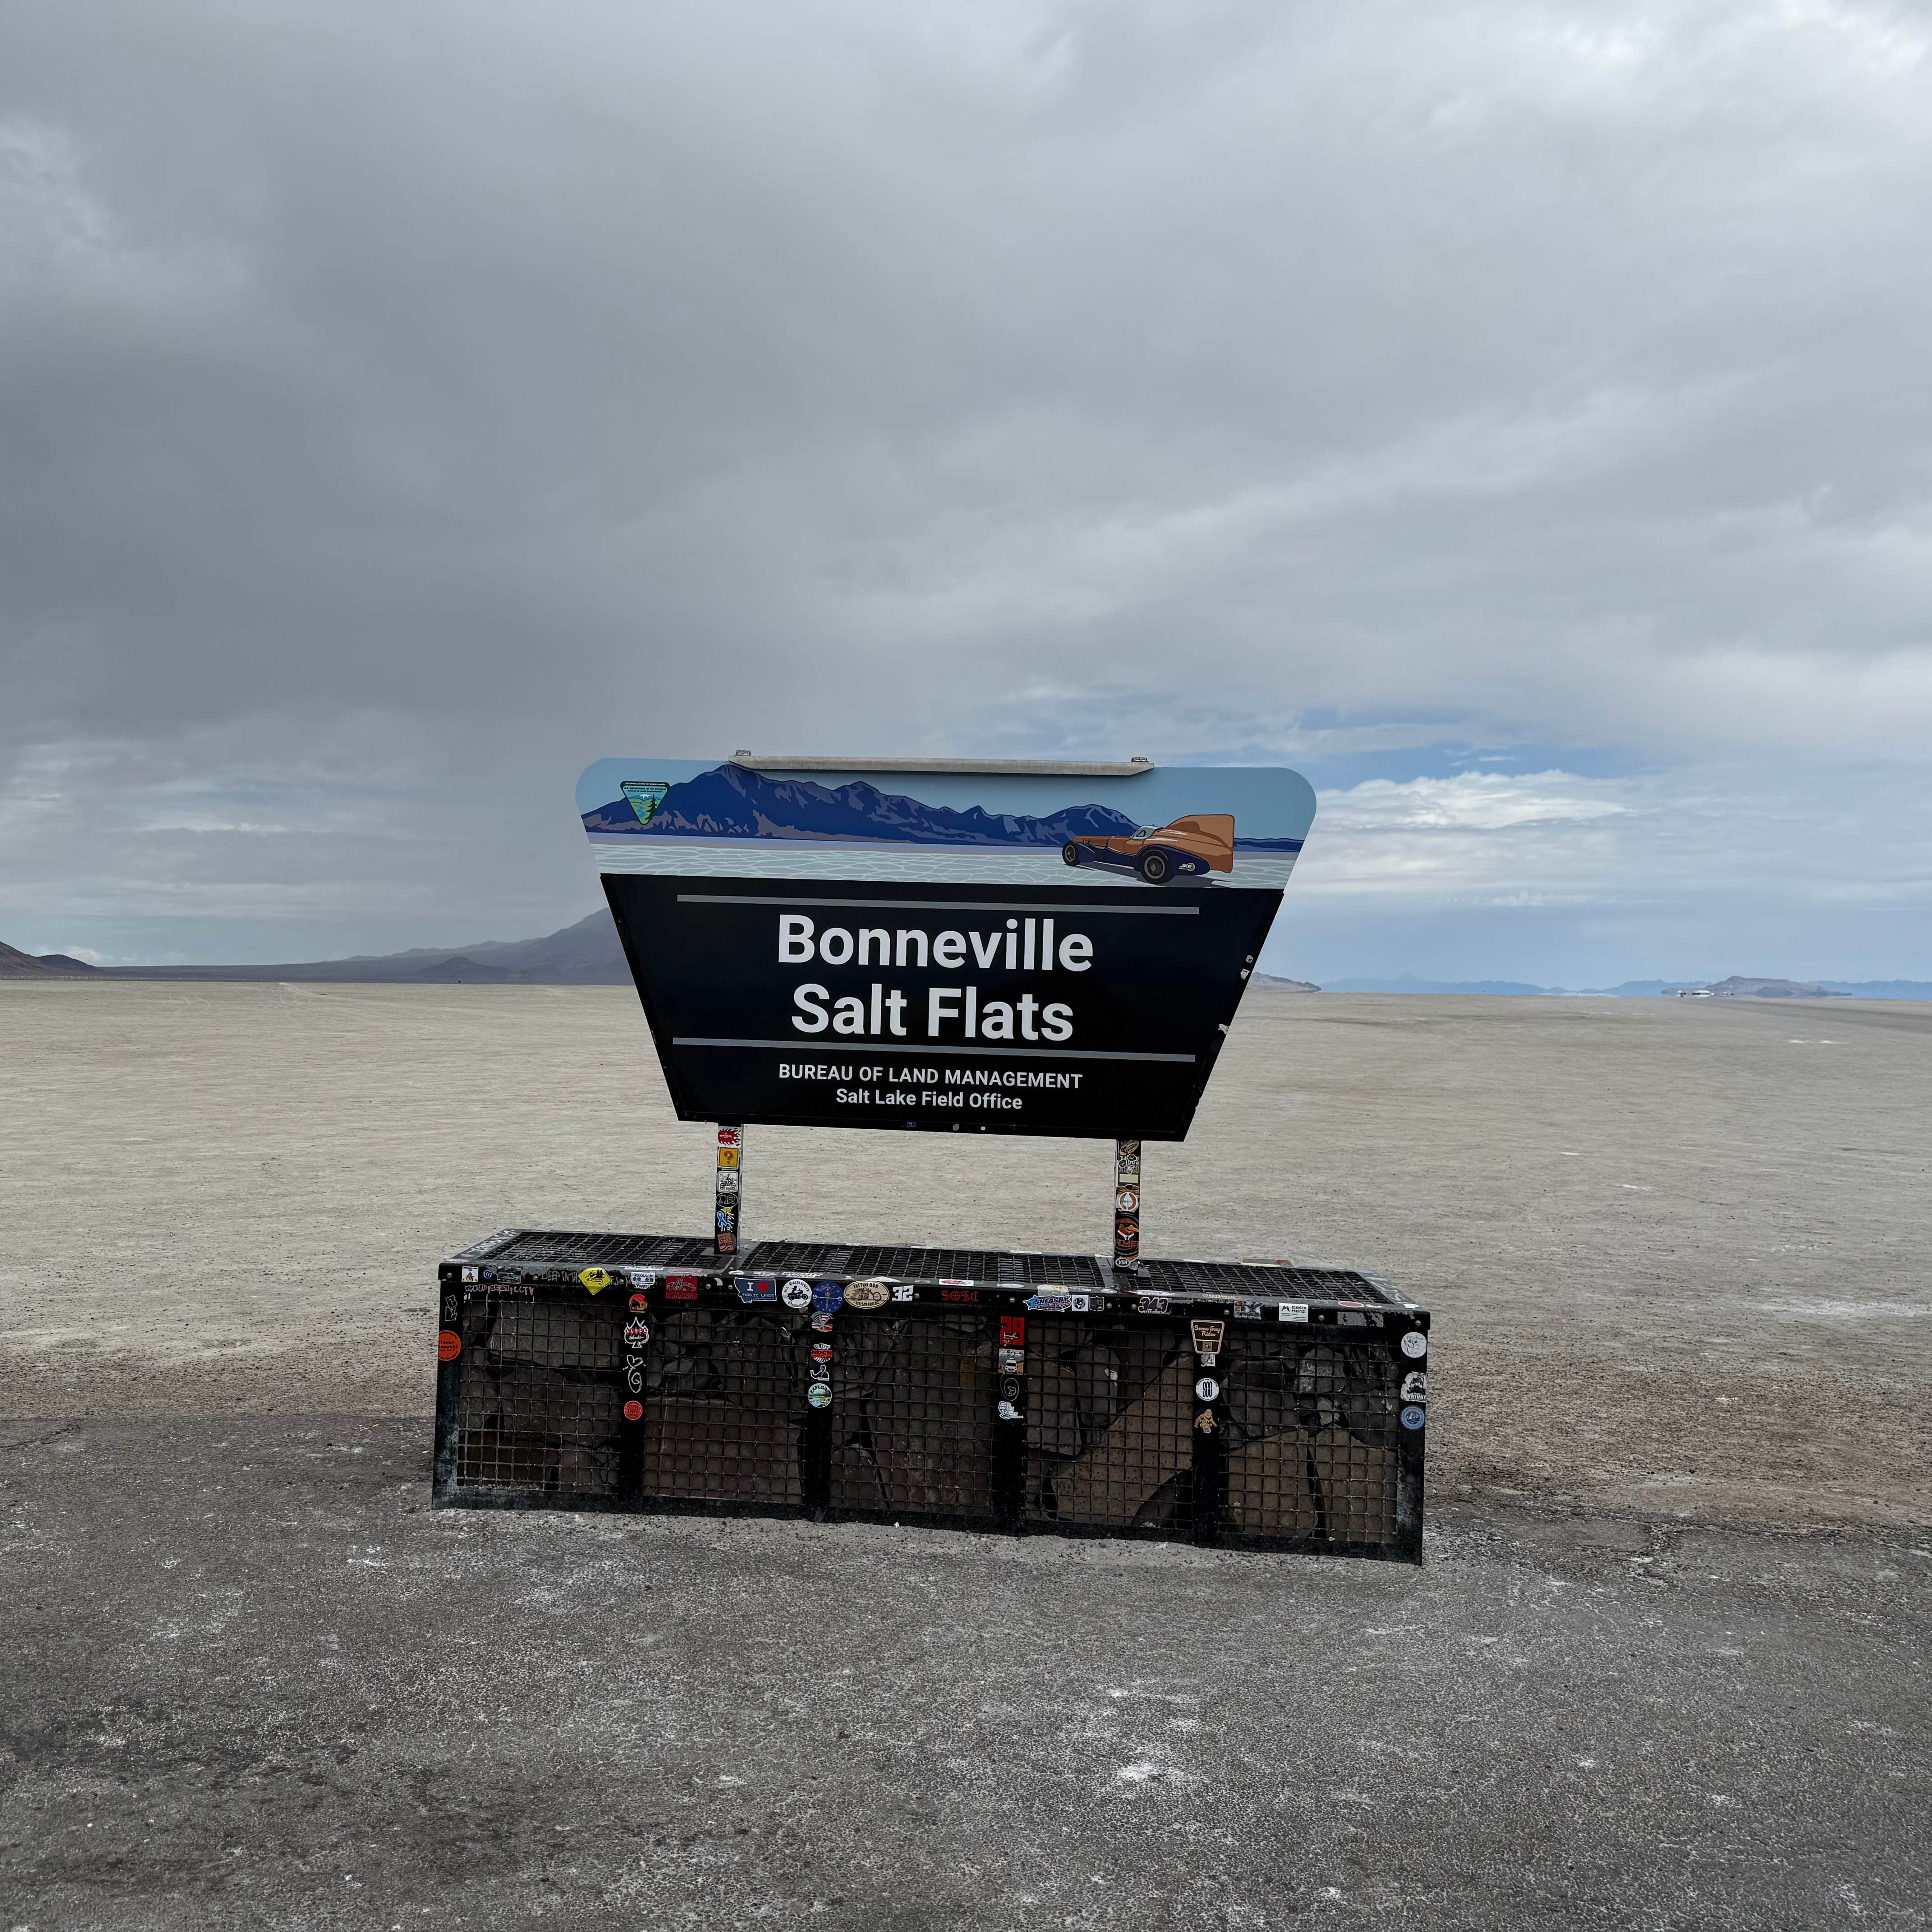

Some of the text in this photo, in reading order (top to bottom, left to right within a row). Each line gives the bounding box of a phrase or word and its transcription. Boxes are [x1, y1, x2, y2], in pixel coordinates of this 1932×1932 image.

[778, 914, 1093, 972] Bonneville
[791, 983, 1073, 1041] Salt Flats
[779, 1064, 1083, 1089] BUREAU OF LAND MANAGEMENT
[836, 1088, 1022, 1109] Salt Lake Field Office
[747, 1282, 754, 1292] I
[892, 1285, 914, 1302] 32
[1138, 1297, 1169, 1314] 343
[1000, 1316, 1024, 1345] 29
[1210, 1325, 1221, 1334] Guy
